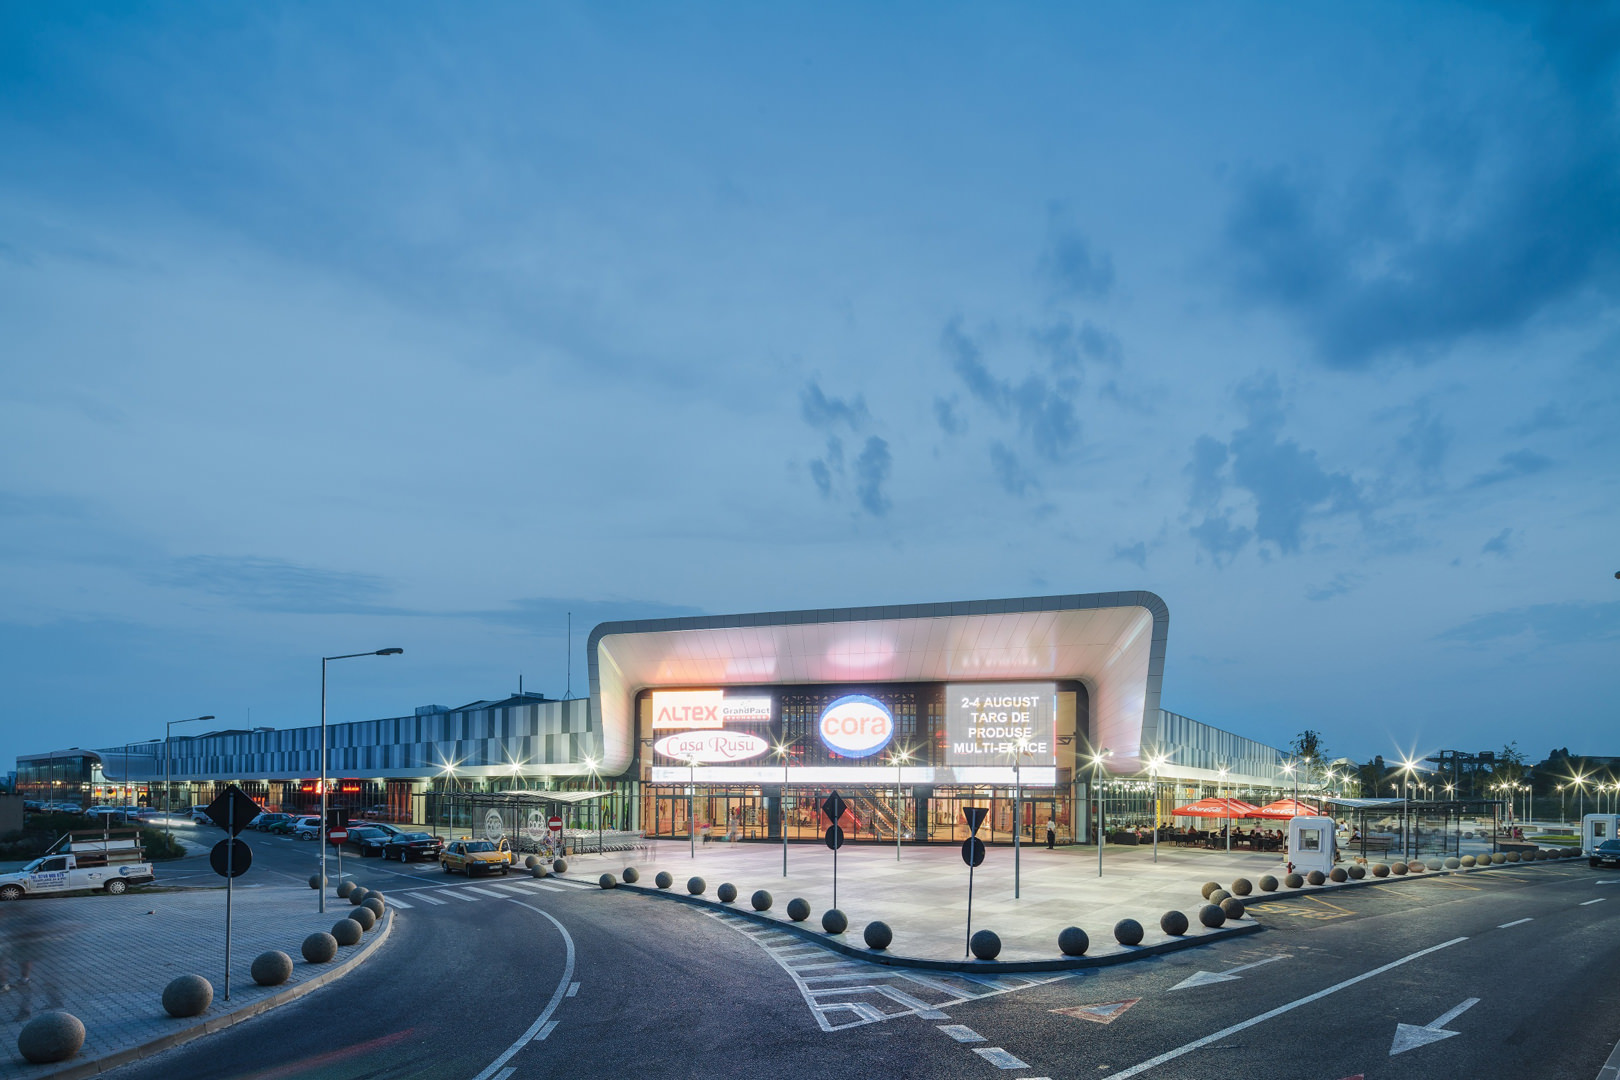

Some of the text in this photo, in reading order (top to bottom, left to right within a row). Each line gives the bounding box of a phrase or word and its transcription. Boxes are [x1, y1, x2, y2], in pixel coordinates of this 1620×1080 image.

[961, 696, 1040, 708] 2-4 AUGUST
[971, 712, 1030, 723] TARG DE
[824, 717, 886, 735] cora
[968, 727, 1032, 738] PRODUSE
[666, 737, 755, 758] Casa Rusu
